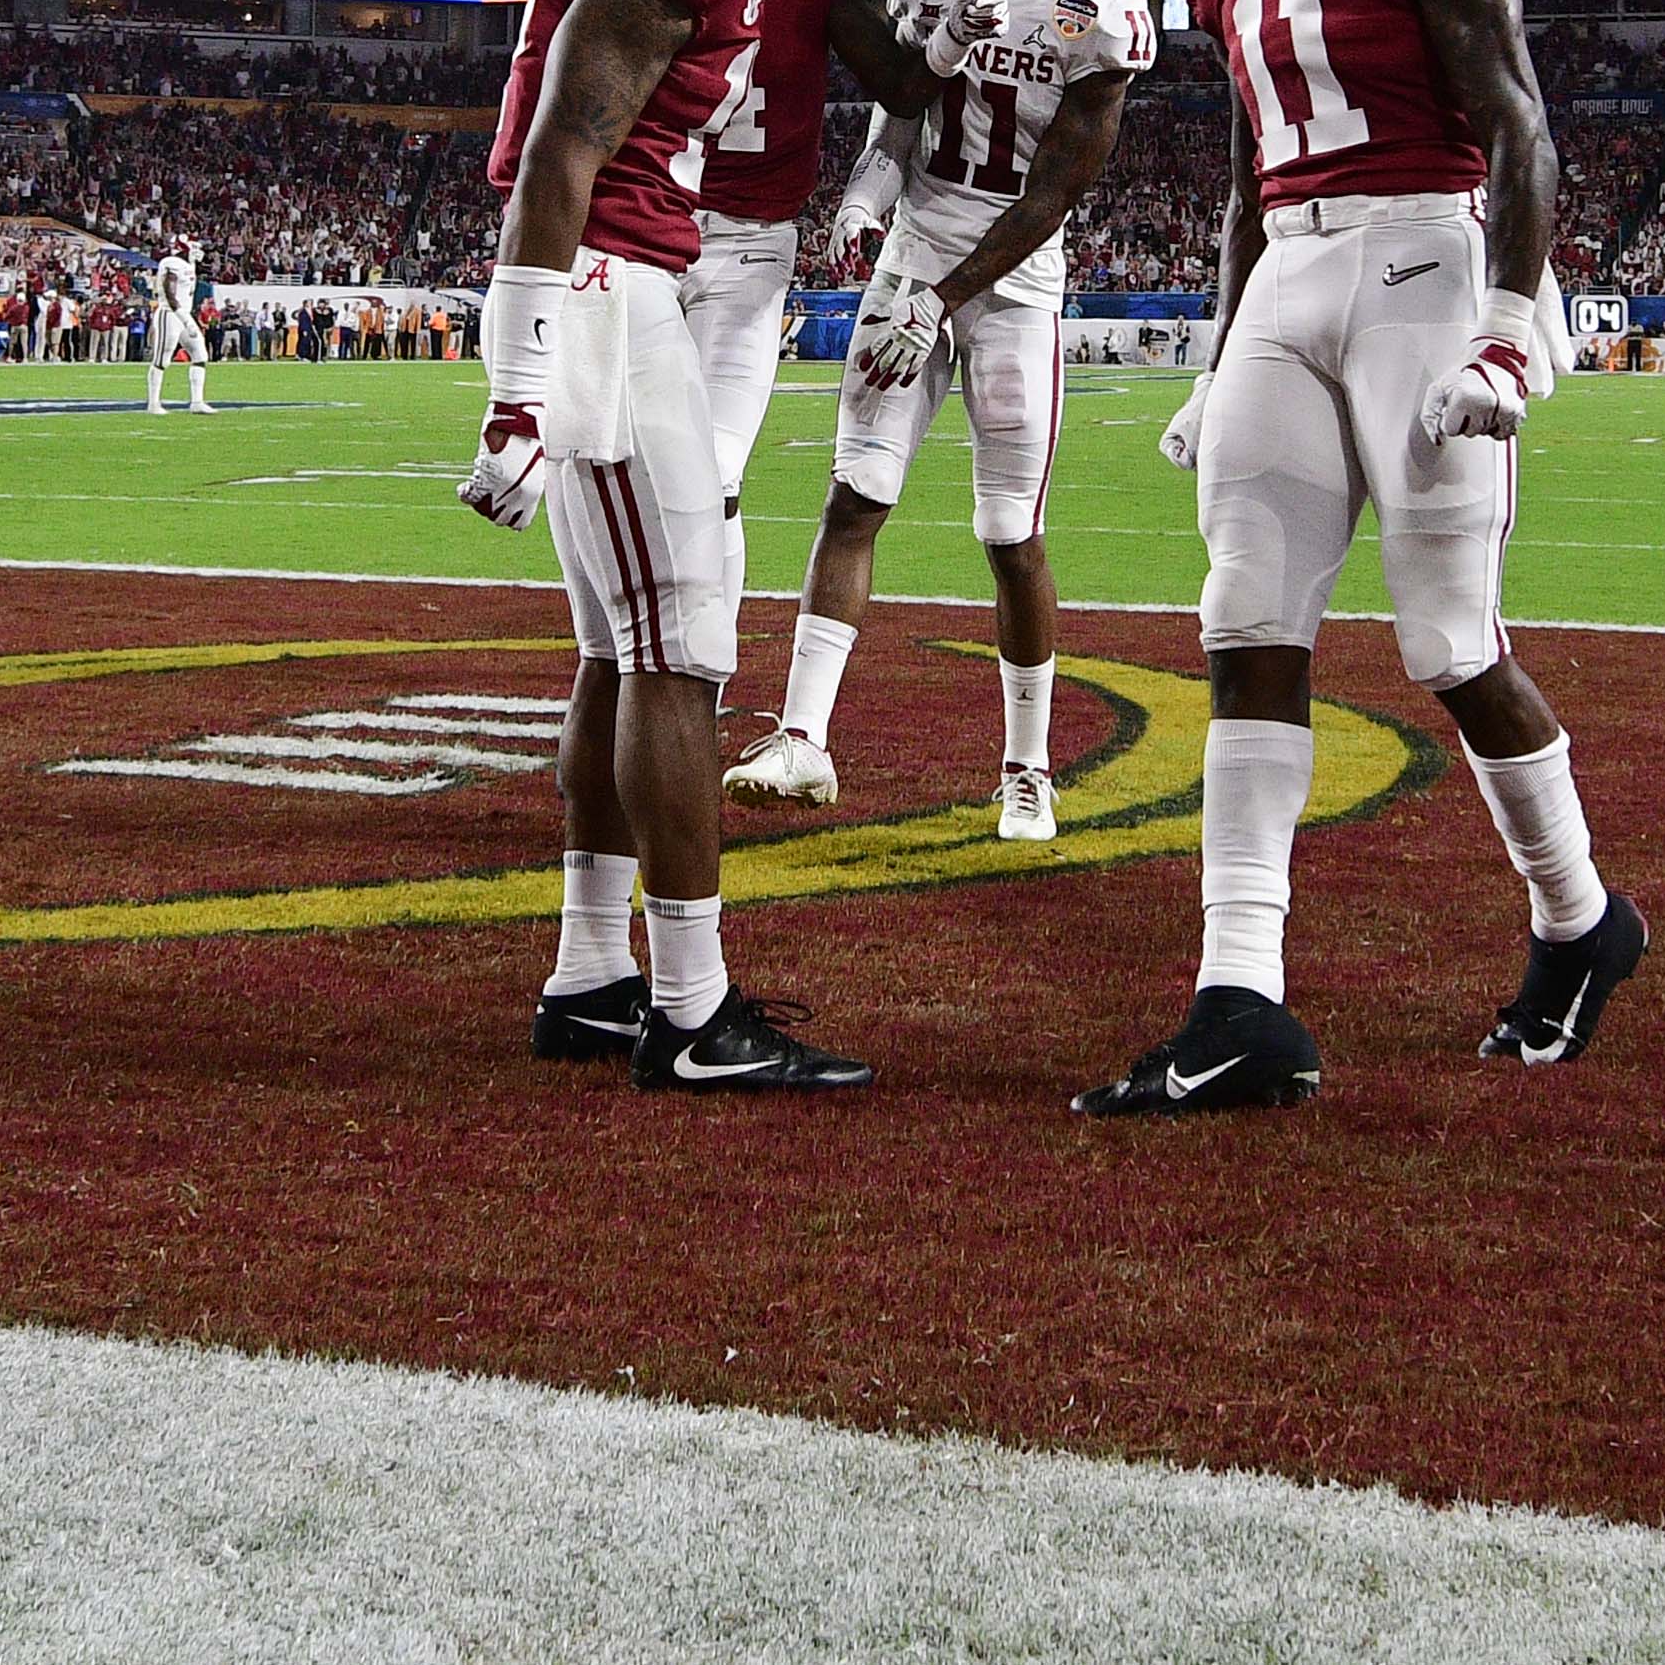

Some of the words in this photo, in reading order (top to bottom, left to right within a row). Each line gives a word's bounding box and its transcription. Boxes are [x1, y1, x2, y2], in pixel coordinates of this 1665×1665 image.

[1124, 10, 1151, 62] 11
[966, 42, 1056, 83] NERS
[926, 78, 1032, 196] 11
[1578, 294, 1622, 332] 04
